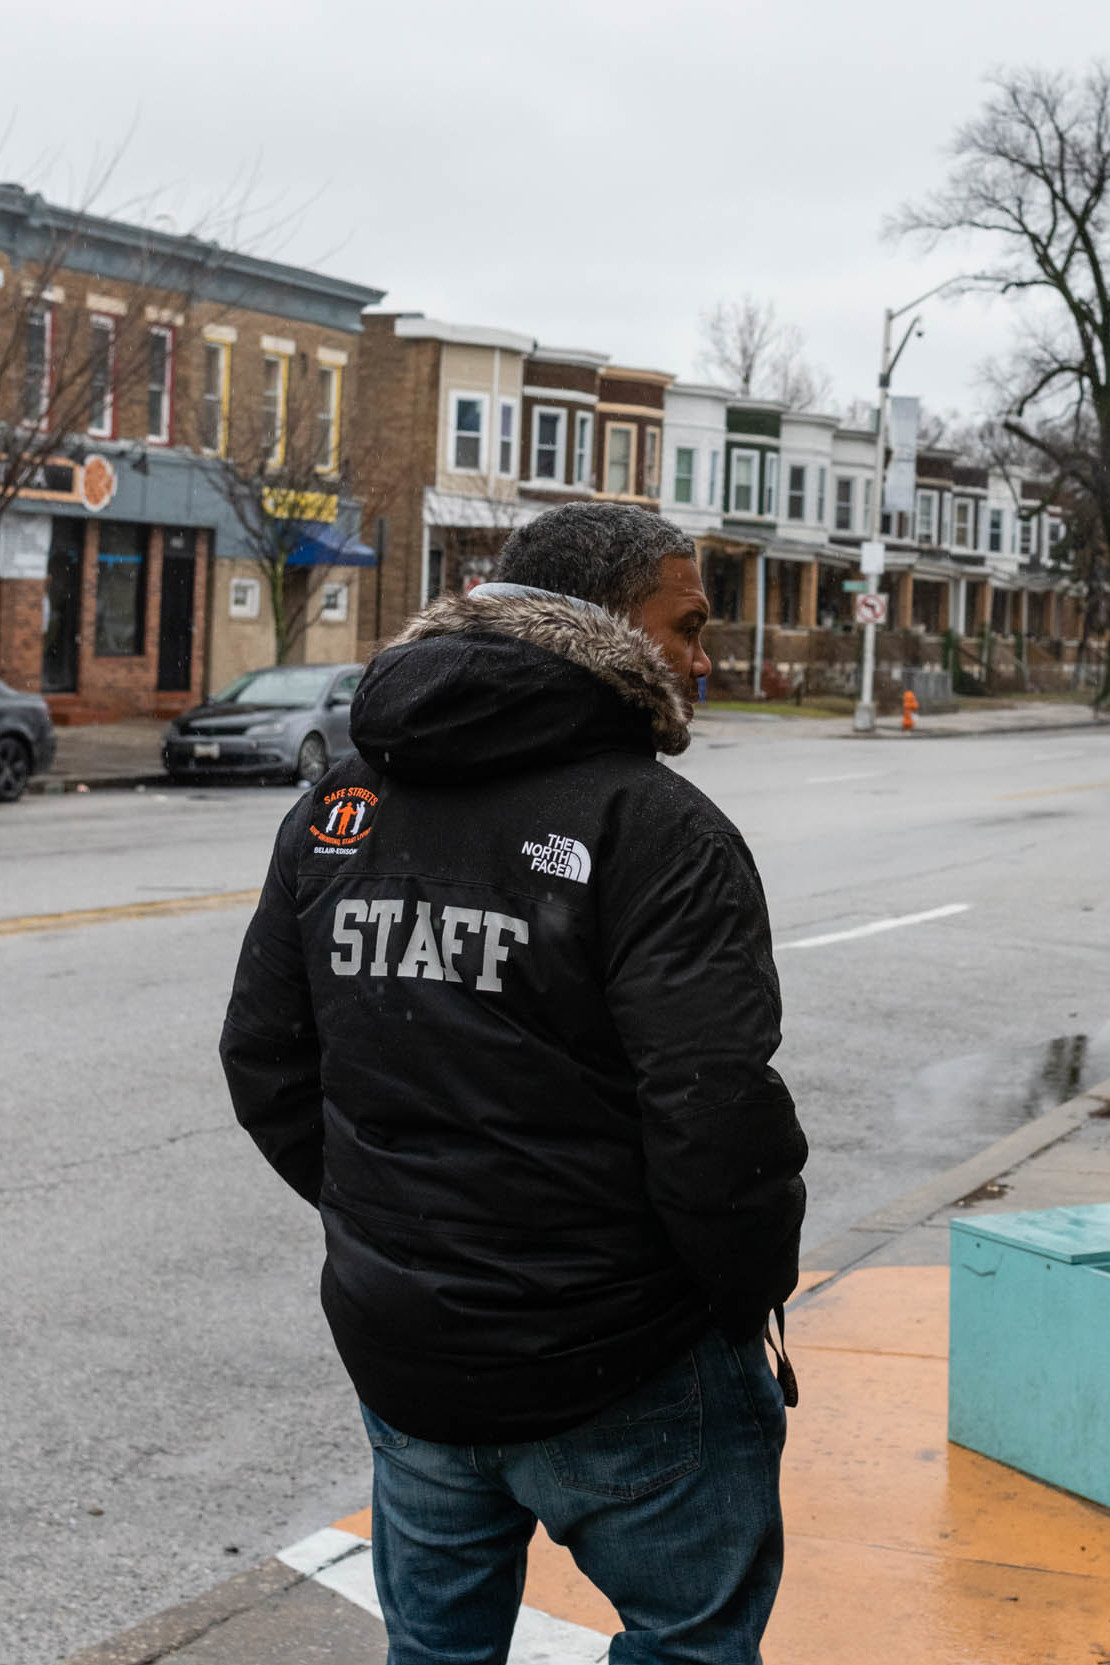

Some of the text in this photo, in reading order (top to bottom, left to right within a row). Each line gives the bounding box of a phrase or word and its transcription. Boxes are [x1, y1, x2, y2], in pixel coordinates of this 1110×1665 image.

[324, 787, 379, 806] SAFE STREETS
[548, 833, 575, 852] THE
[521, 840, 571, 866] NORTH
[530, 857, 566, 877] FACE
[331, 899, 529, 992] STAFF
